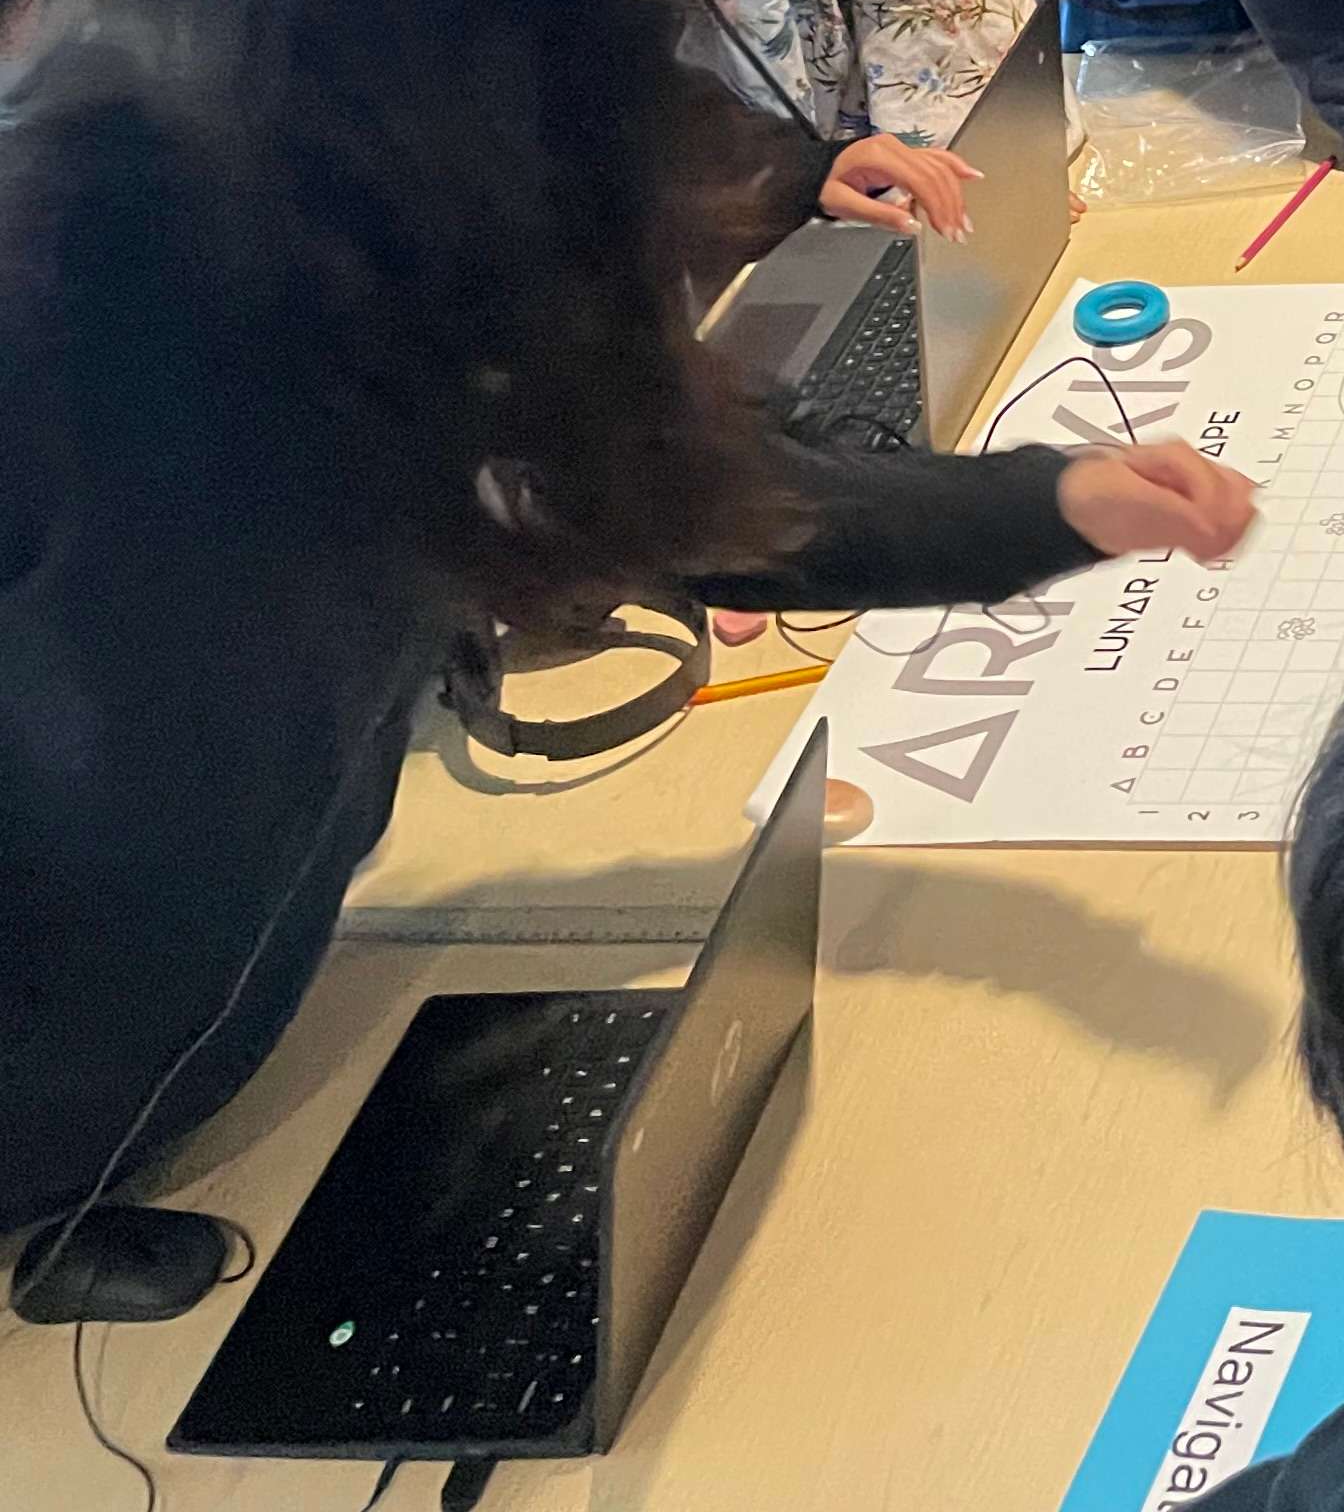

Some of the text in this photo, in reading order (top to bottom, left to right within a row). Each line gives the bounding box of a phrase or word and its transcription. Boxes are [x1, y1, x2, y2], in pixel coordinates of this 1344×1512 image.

[1304, 355, 1325, 366] P
[1294, 378, 1315, 391] O
[1284, 403, 1305, 415] N
[1271, 427, 1295, 439] M
[1258, 453, 1283, 463] L
[858, 317, 1213, 804] ARKIS
[1196, 587, 1220, 601] G
[1084, 578, 1160, 671] LUNAR
[1182, 617, 1206, 629] F
[1166, 648, 1194, 662] E
[1152, 677, 1180, 691] D
[1139, 711, 1165, 725] C
[1122, 745, 1150, 758] B
[1187, 810, 1210, 821] 2
[1238, 810, 1260, 821] 3
